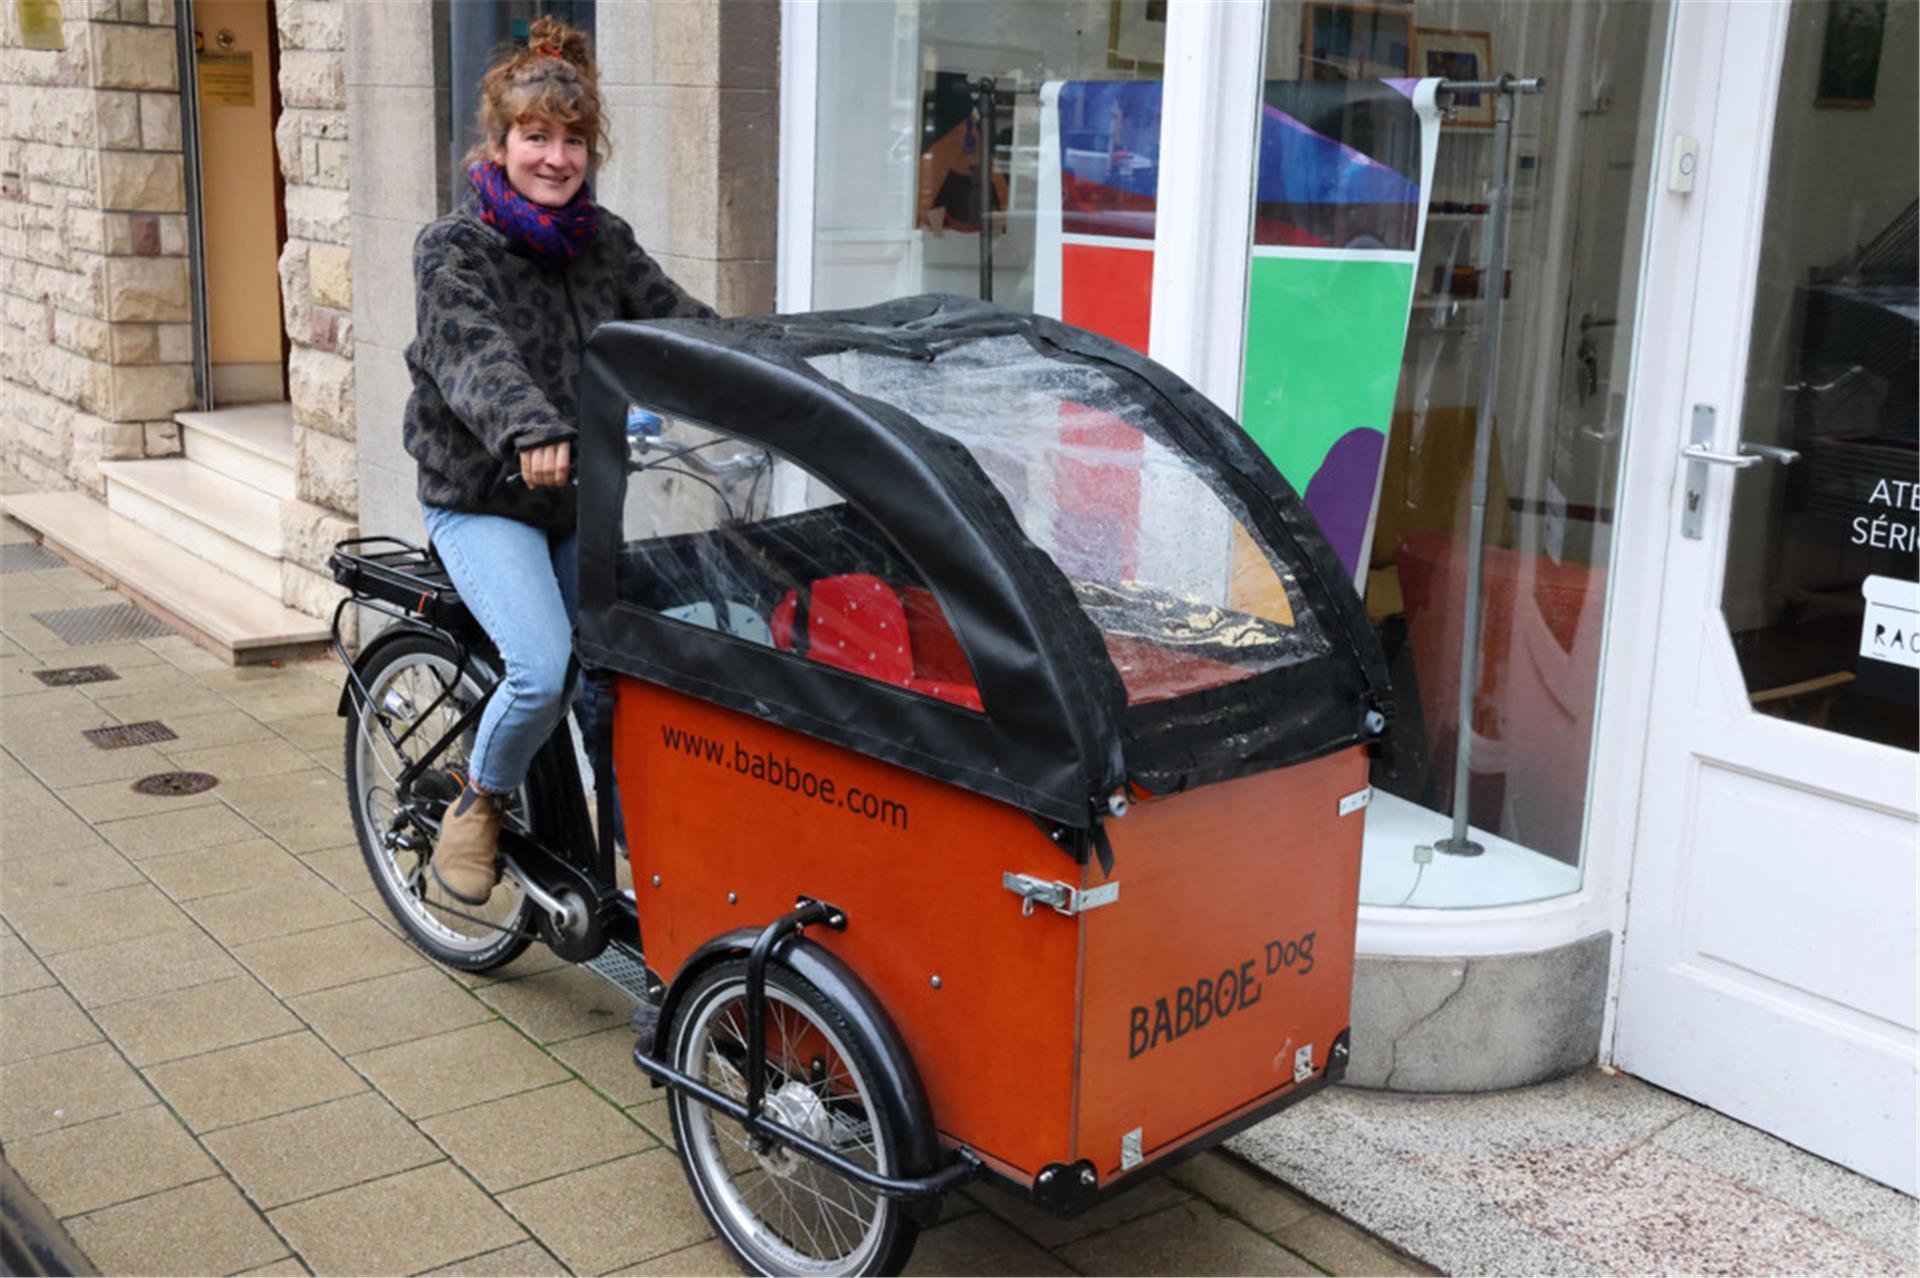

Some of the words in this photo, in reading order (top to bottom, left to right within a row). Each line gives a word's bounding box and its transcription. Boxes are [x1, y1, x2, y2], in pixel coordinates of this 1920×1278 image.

[1851, 514, 1919, 552] SÉRI
[661, 724, 908, 830] www.babboe.com
[1128, 959, 1262, 1060] BABBOE
[1265, 932, 1316, 976] Dog
